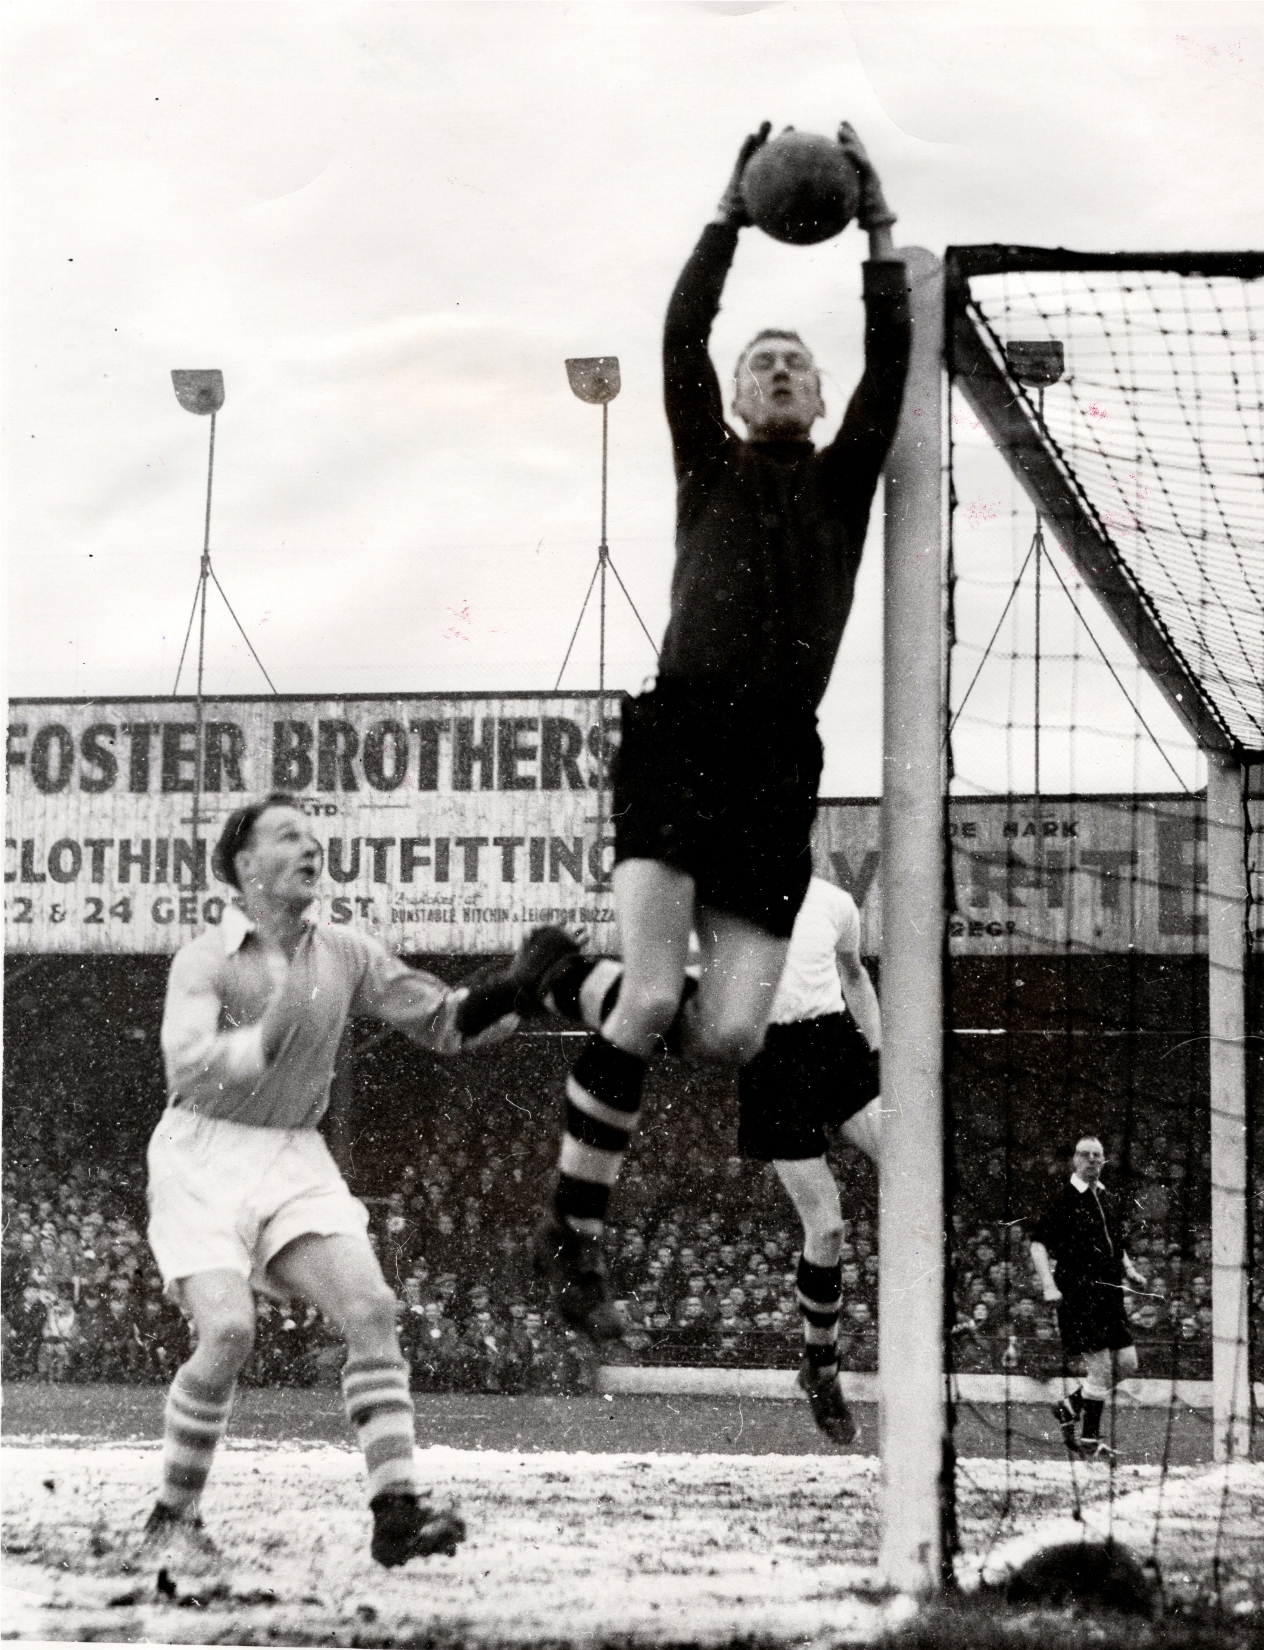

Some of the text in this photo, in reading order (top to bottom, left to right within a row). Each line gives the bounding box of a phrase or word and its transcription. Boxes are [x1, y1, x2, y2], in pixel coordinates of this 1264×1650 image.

[6, 717, 622, 793] FOSTER BROTHERS
[1002, 820, 1079, 838] MARK
[4, 836, 615, 884] LOTHIN UTFITTING
[49, 903, 66, 924] &
[82, 897, 133, 924] 24
[151, 896, 240, 925] GEO
[579, 906, 616, 923] BUZZA
